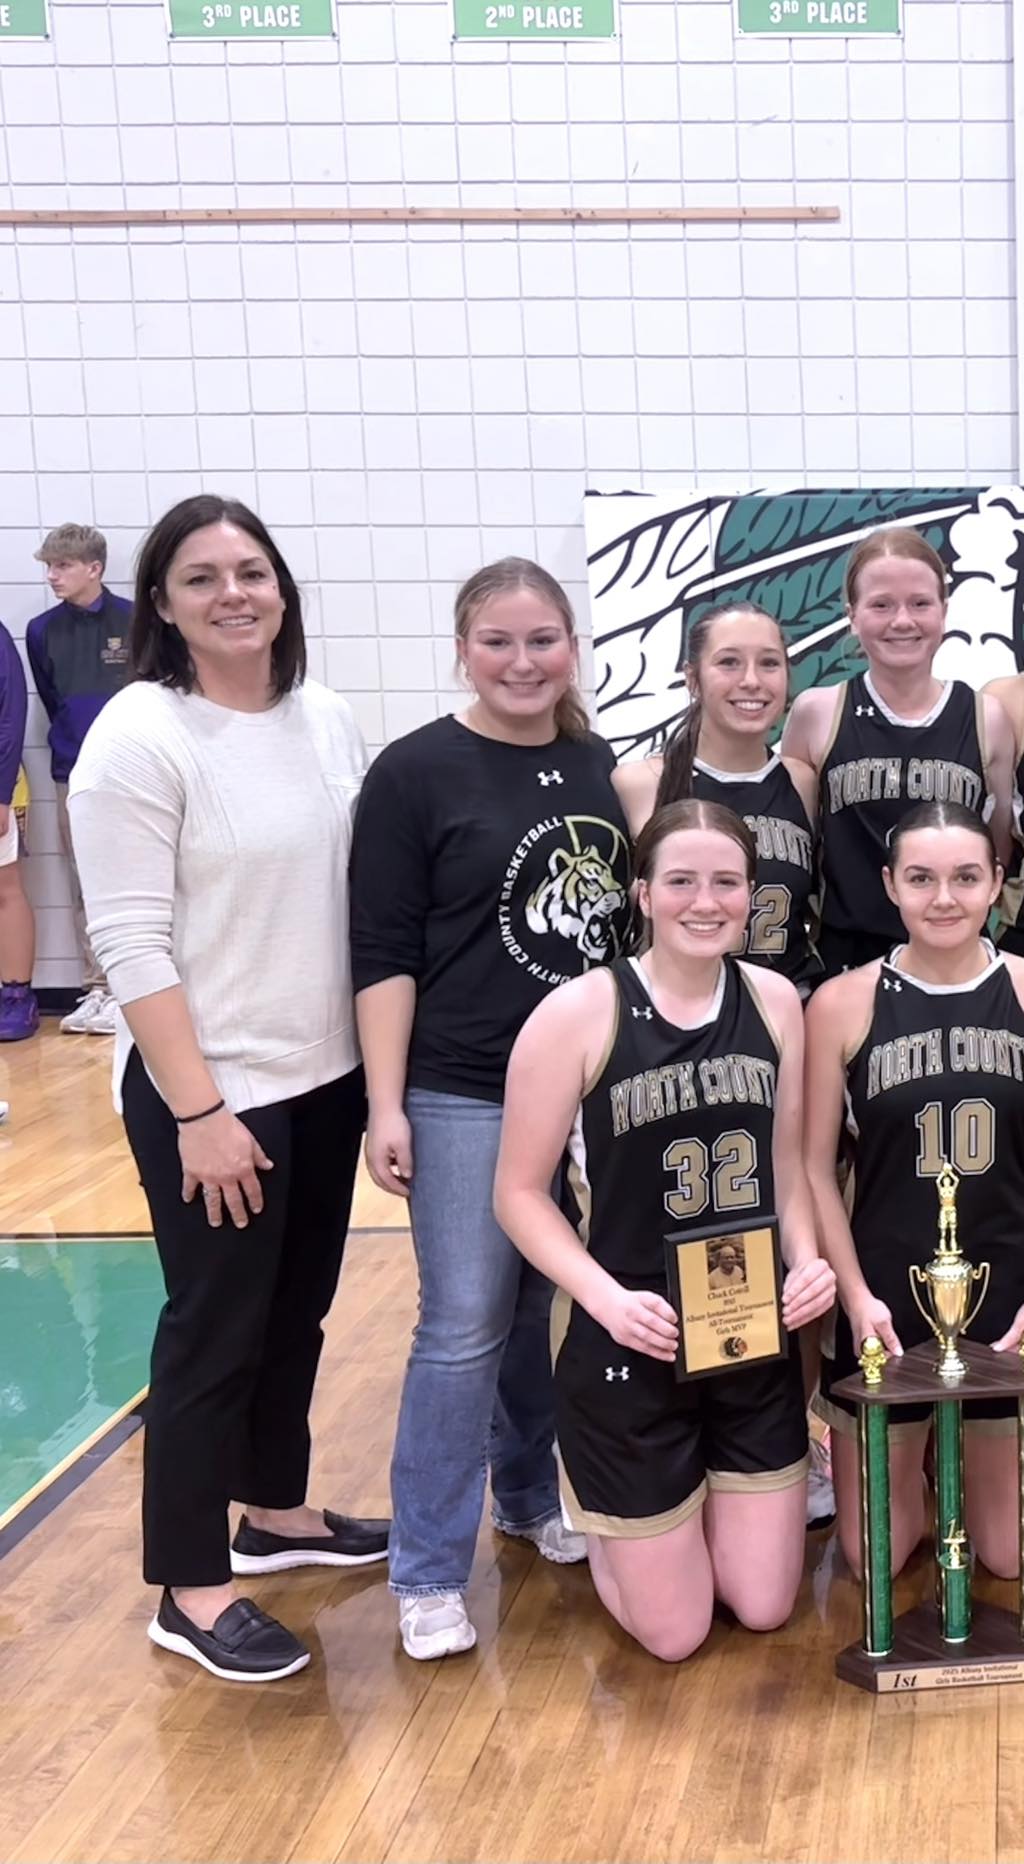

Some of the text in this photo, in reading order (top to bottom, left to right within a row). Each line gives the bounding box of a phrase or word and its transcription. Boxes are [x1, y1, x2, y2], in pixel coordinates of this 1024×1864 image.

[202, 4, 301, 28] 3RD PLACE
[485, 5, 583, 29] 2ND PLACE
[769, 0, 867, 24] 3RD PLACE
[827, 757, 902, 815] NORTH
[498, 815, 572, 986] ORTH COUNTY BASKETBALL
[730, 884, 793, 955] 2
[609, 1060, 698, 1137] NORTH
[866, 1027, 944, 1100] NORTH
[914, 1097, 996, 1178] 10
[662, 1128, 761, 1220] 32
[893, 1673, 918, 1688] 1st
